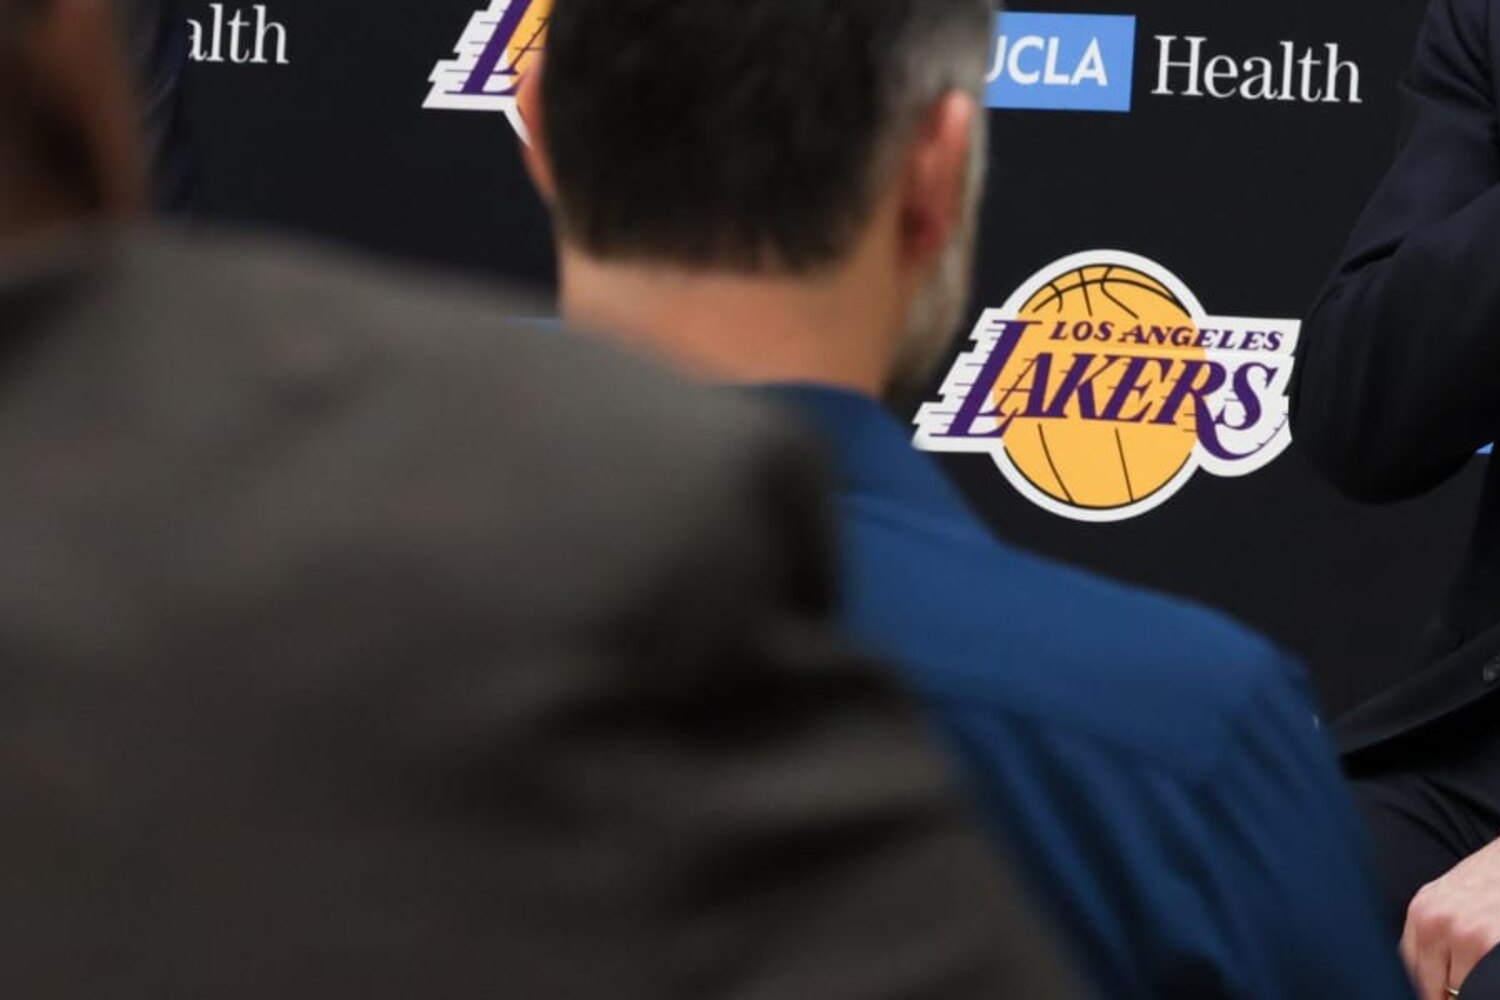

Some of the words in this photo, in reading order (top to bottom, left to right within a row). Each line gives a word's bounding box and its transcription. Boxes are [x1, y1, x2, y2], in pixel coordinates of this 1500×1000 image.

[186, 2, 290, 64] alth
[1151, 34, 1362, 103] Health
[1049, 320, 1115, 343] LOS
[1118, 323, 1283, 352] ANGELES
[929, 319, 1289, 462] LAKERS
